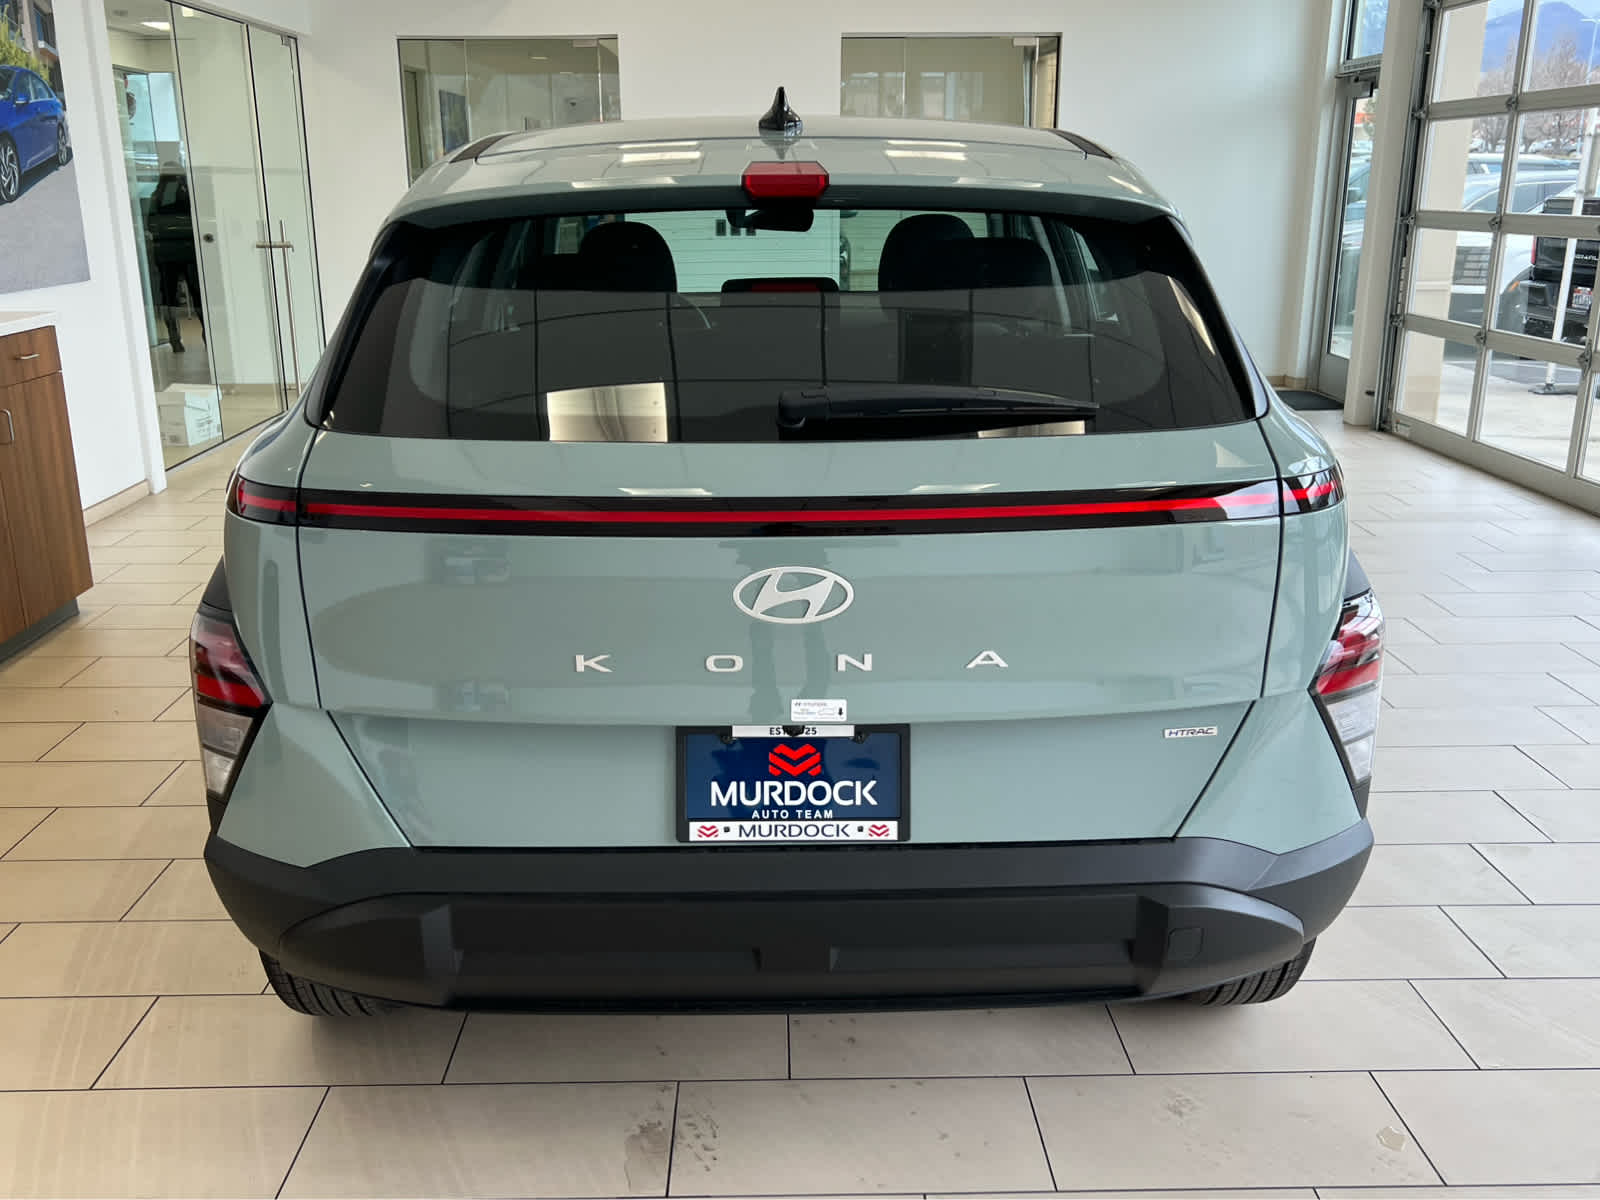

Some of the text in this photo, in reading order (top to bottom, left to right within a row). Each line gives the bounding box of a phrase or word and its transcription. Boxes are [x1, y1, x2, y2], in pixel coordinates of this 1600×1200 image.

[1168, 727, 1215, 737] HTRAC
[710, 780, 878, 806] MURDOCK
[751, 809, 833, 819] AUTO TEAM
[738, 823, 851, 838] MURDOCK
